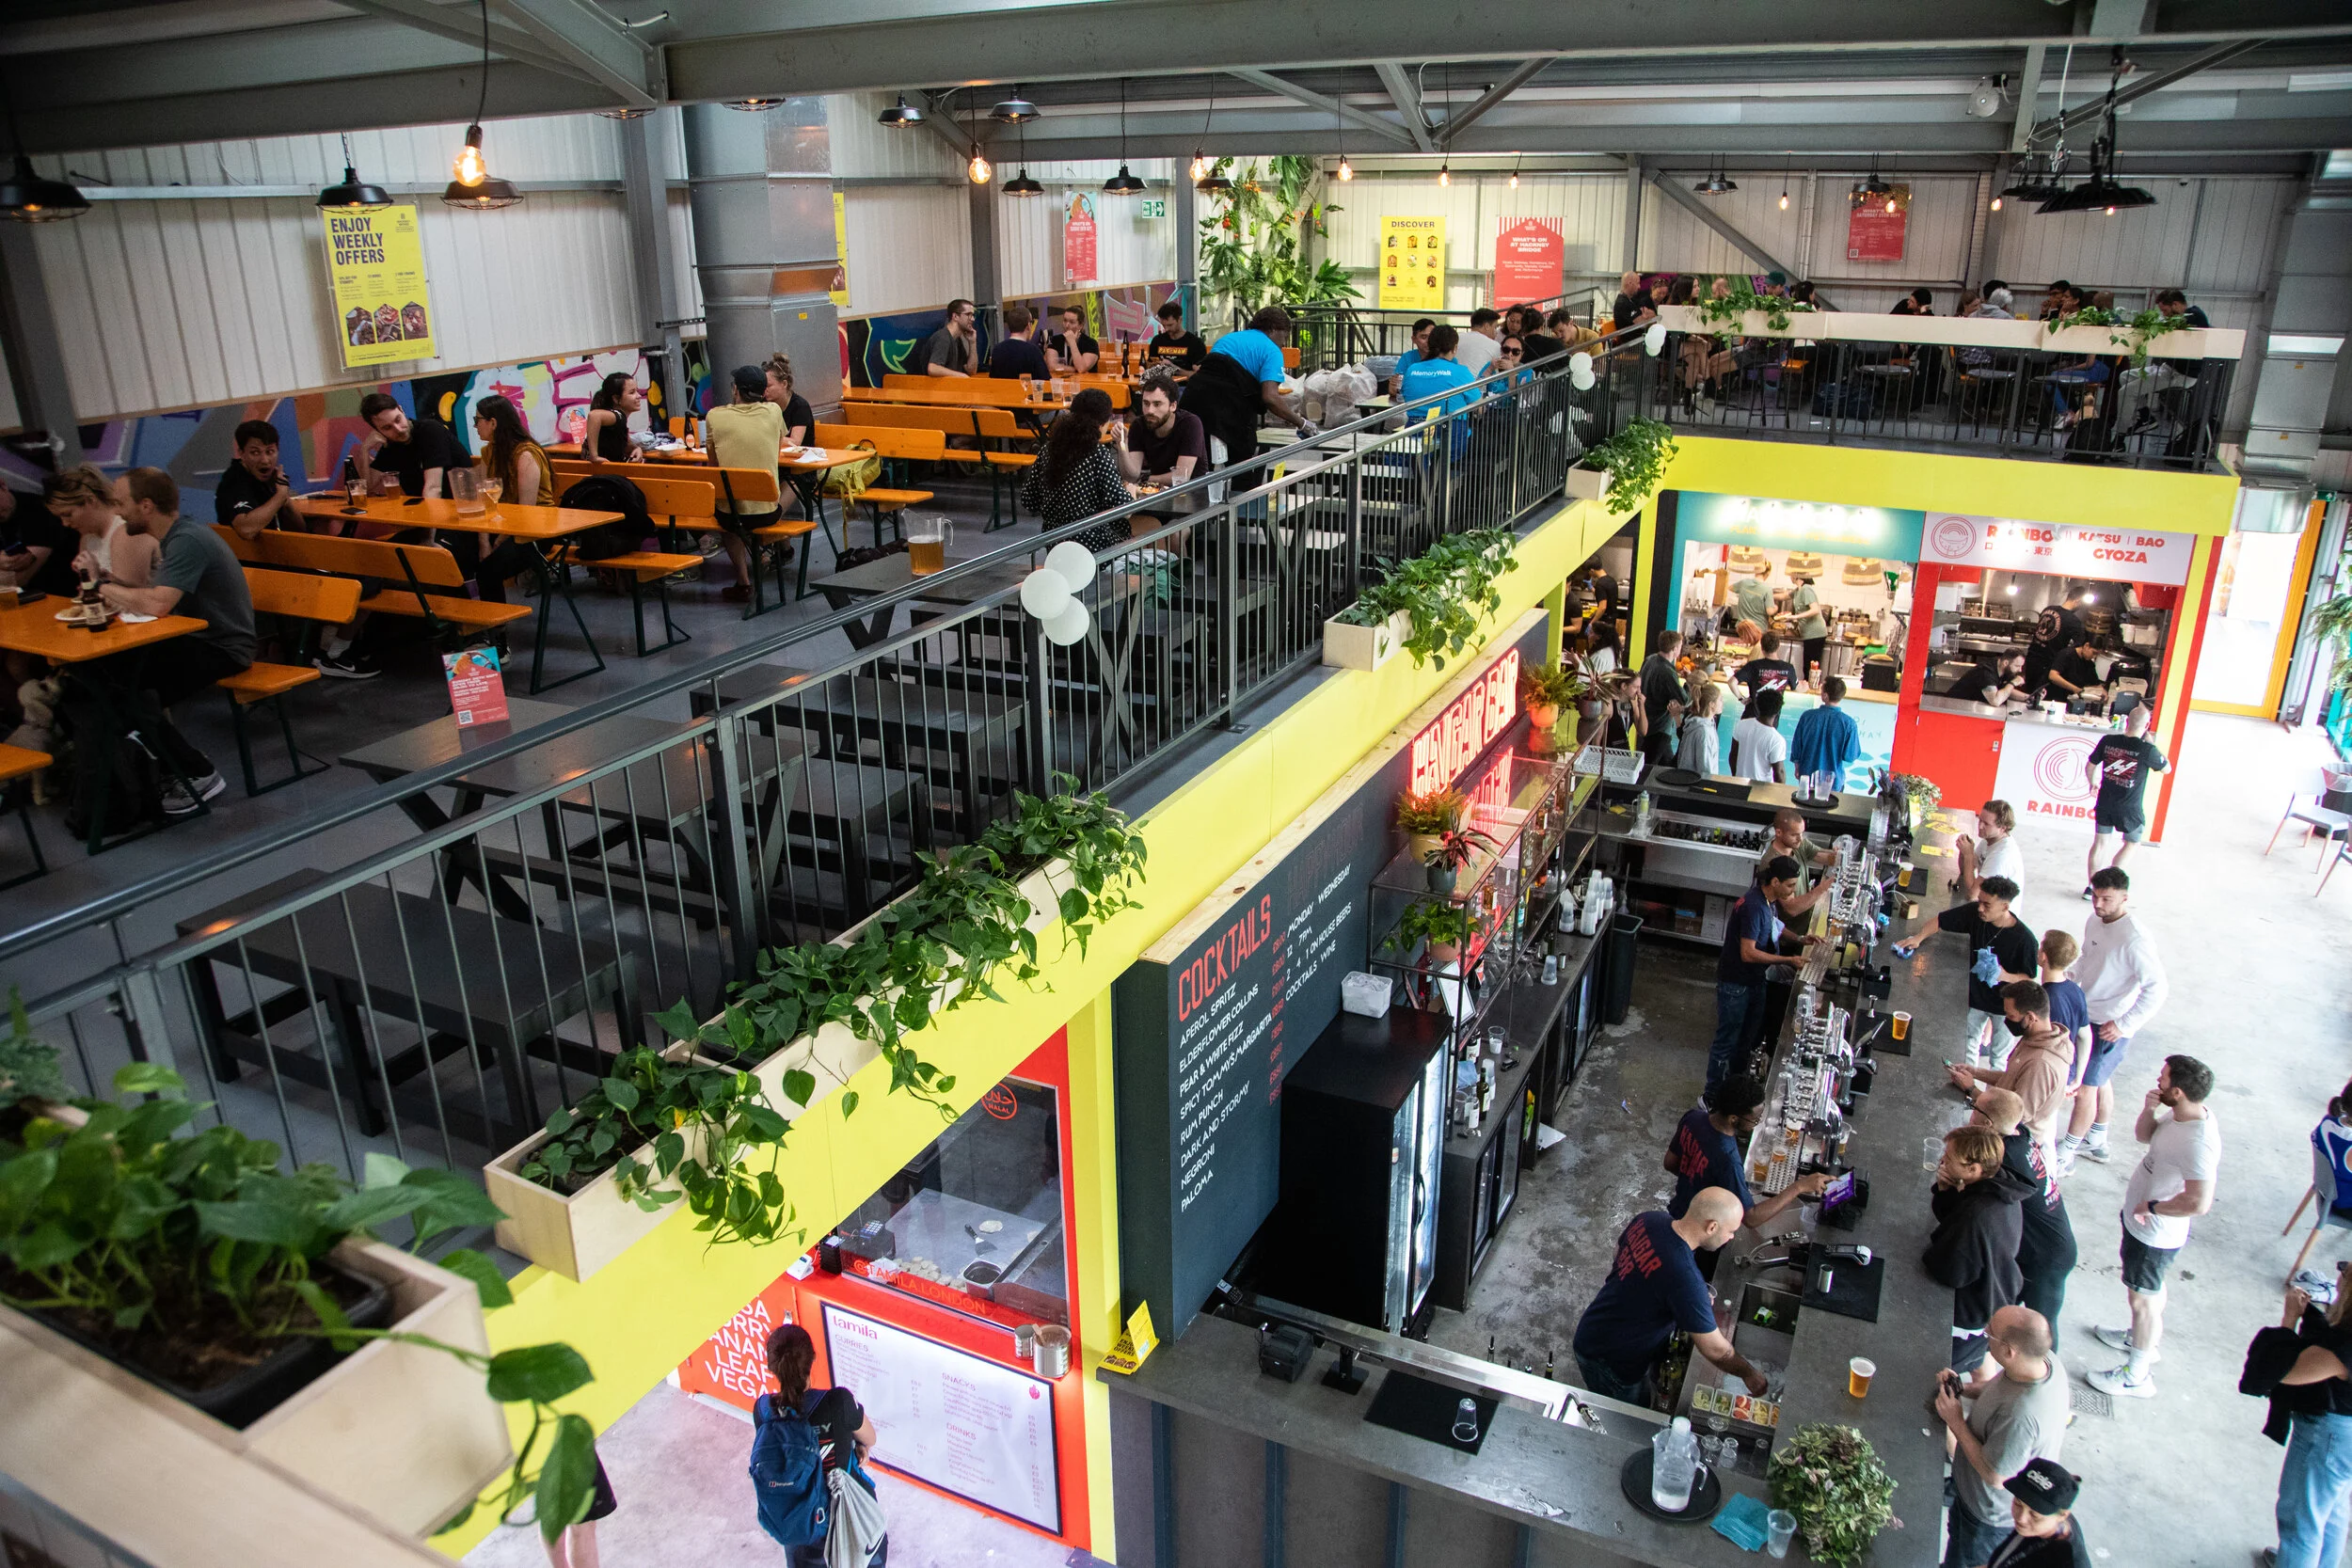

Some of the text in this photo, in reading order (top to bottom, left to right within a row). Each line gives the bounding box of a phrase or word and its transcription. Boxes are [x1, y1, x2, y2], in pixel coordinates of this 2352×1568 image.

[330, 217, 371, 233] ENJOY
[332, 232, 383, 249] WEEKLY
[336, 248, 385, 265] OFFERS
[1987, 525, 2054, 543] RNBO
[2136, 536, 2165, 547] BAO
[2093, 548, 2148, 563] GYOZA
[1413, 648, 1519, 799] HANGAR BAR
[1287, 863, 1351, 938] MONDAY WEDNESDAY
[1286, 969, 1291, 981] 2
[1296, 957, 1301, 968] 4
[1310, 938, 1318, 955] ON
[1318, 920, 1335, 945] HOUSE
[1336, 902, 1352, 928] BEERS
[1298, 926, 1312, 946] 7PM
[1179, 895, 1270, 1022] COCKTAILS
[1285, 940, 1336, 1001] COCKTAILS WINE
[1180, 1012, 1210, 1049] APEROL
[1210, 982, 1236, 1017] SPRITZ
[1180, 1012, 1232, 1073] ELDERFLOWER
[1232, 984, 1259, 1019] COLLINS
[1180, 1069, 1200, 1098] PEAR
[1200, 1063, 1206, 1077] &
[1205, 1039, 1228, 1069] WHITE
[1228, 1021, 1244, 1046] FIZZ
[1180, 1091, 1200, 1120] SPICY
[1201, 1052, 1235, 1098] TOMMY'S
[1234, 1012, 1272, 1061] MARGARITA
[988, 1103, 1010, 1115] HALAL
[1180, 1117, 1198, 1147] RUM
[1198, 1089, 1223, 1126] PUNCH
[1181, 1139, 1202, 1168] DARK
[1202, 1117, 1220, 1146] AND
[1220, 1080, 1250, 1123] STORMY
[1181, 1143, 1216, 1190] NEGRONI
[1181, 1168, 1214, 1213] PALOMA
[1627, 1218, 1662, 1279] HANGAR
[854, 1259, 986, 1314] @TAMILA.LONDON
[833, 1315, 878, 1340] tamila
[835, 1334, 868, 1353] CURRIES
[715, 1345, 773, 1383] LEAF
[1114, 1347, 1135, 1356] OFFERS
[705, 1360, 777, 1399] VEGA
[942, 1372, 977, 1391] SNACKS
[946, 1422, 977, 1440] DRINKS
[2026, 1469, 2055, 1490] ciele
